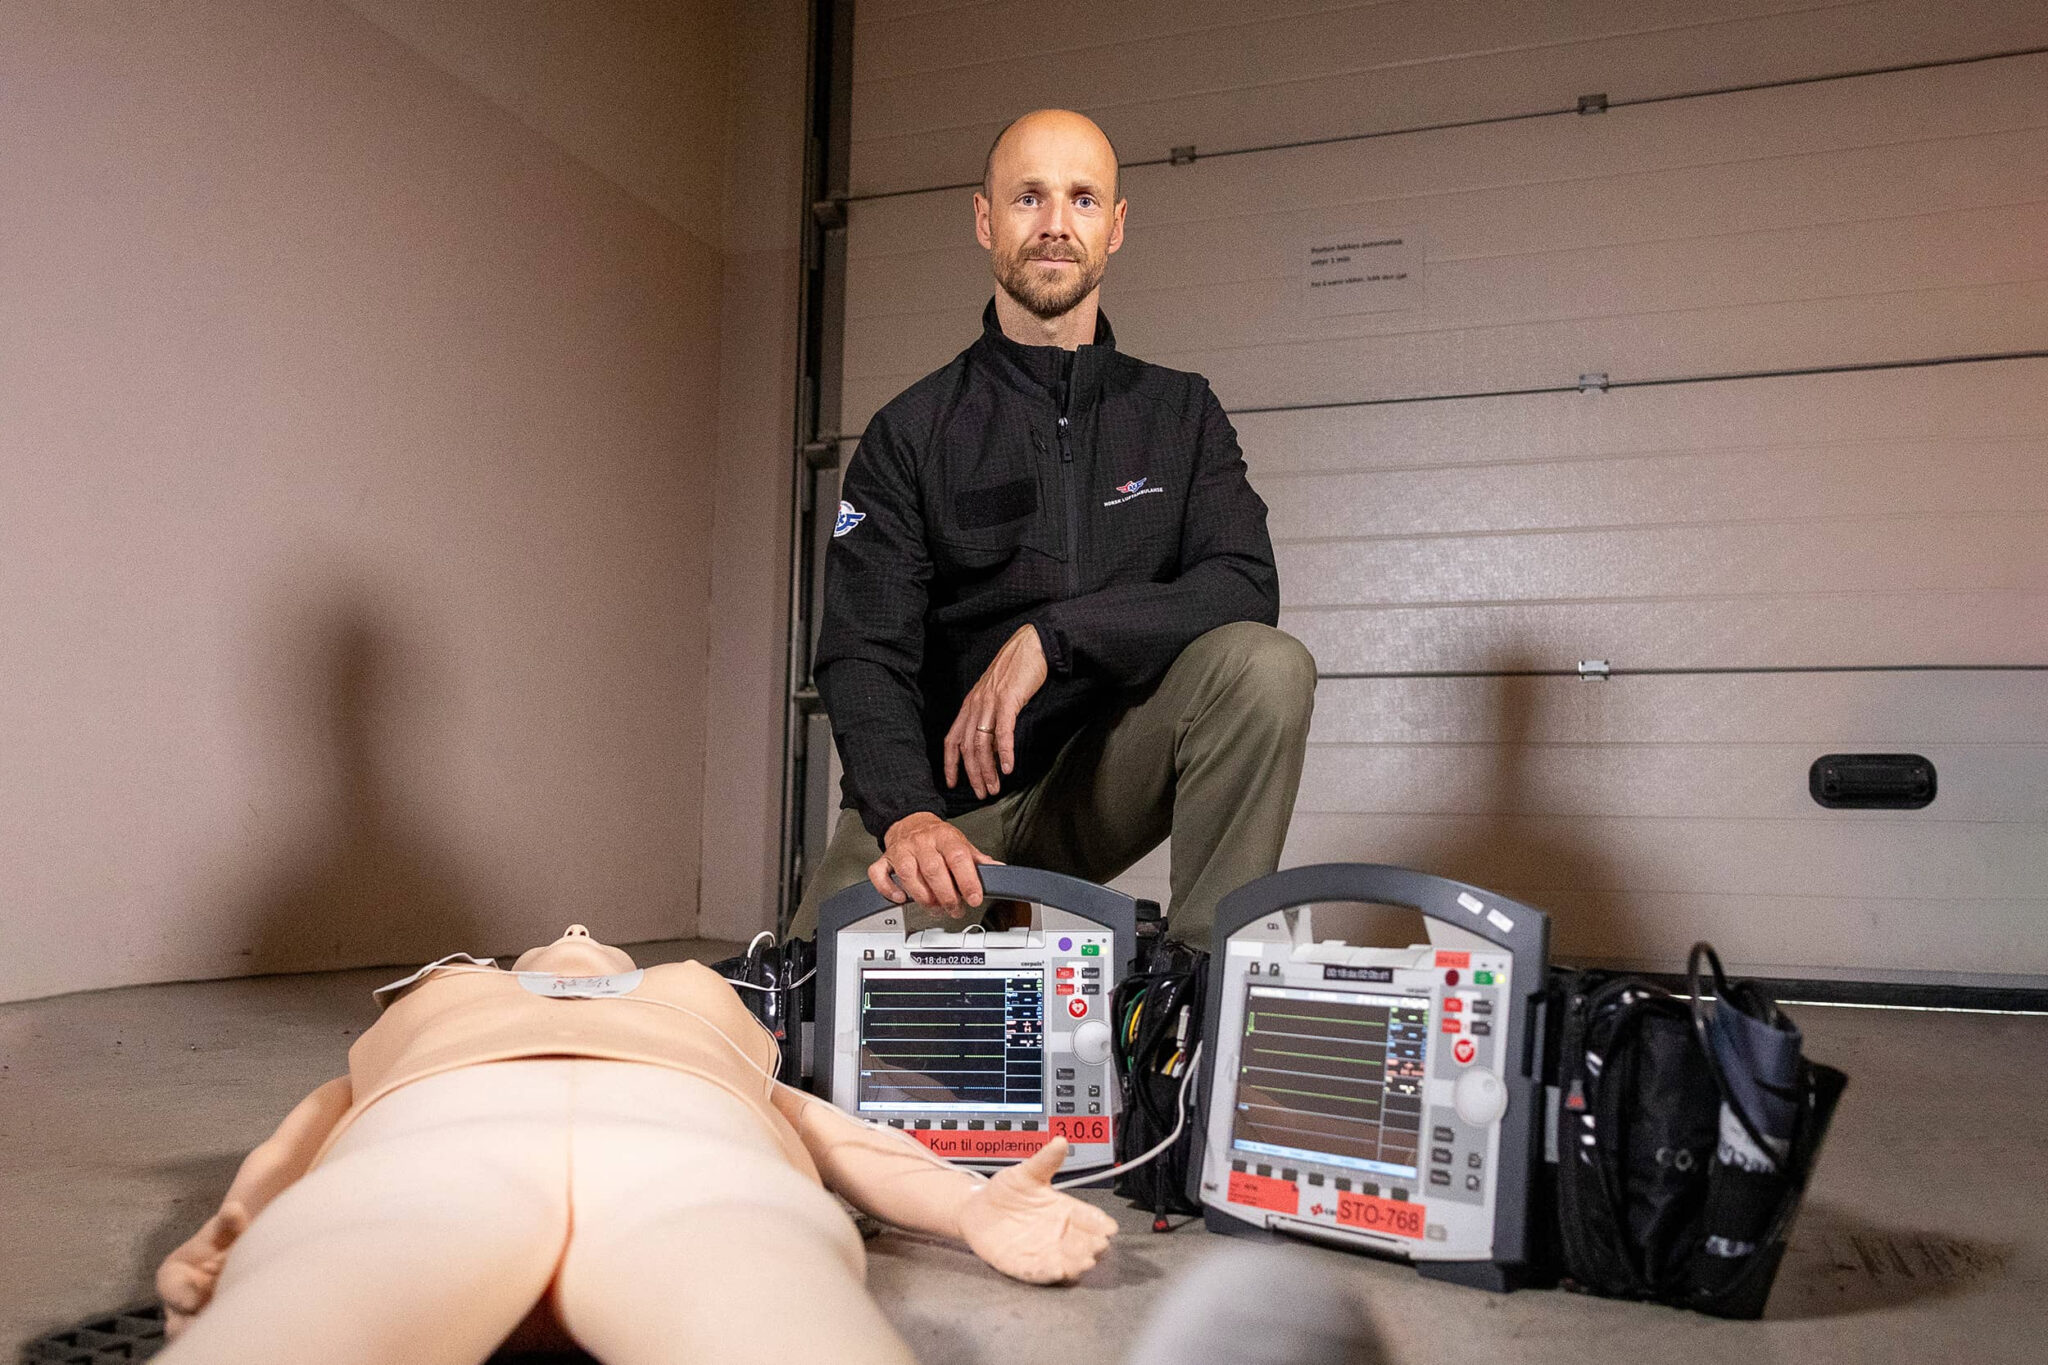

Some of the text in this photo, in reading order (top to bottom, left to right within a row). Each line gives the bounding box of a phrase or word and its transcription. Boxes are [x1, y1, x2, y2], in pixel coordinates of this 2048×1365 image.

[1104, 487, 1163, 507] NORSK LUFTAMBULANSE
[1055, 1121, 1104, 1139] 3.0.6
[930, 1138, 957, 1151] Kun
[961, 1137, 972, 1151] til
[1340, 1199, 1419, 1232] STO-768
